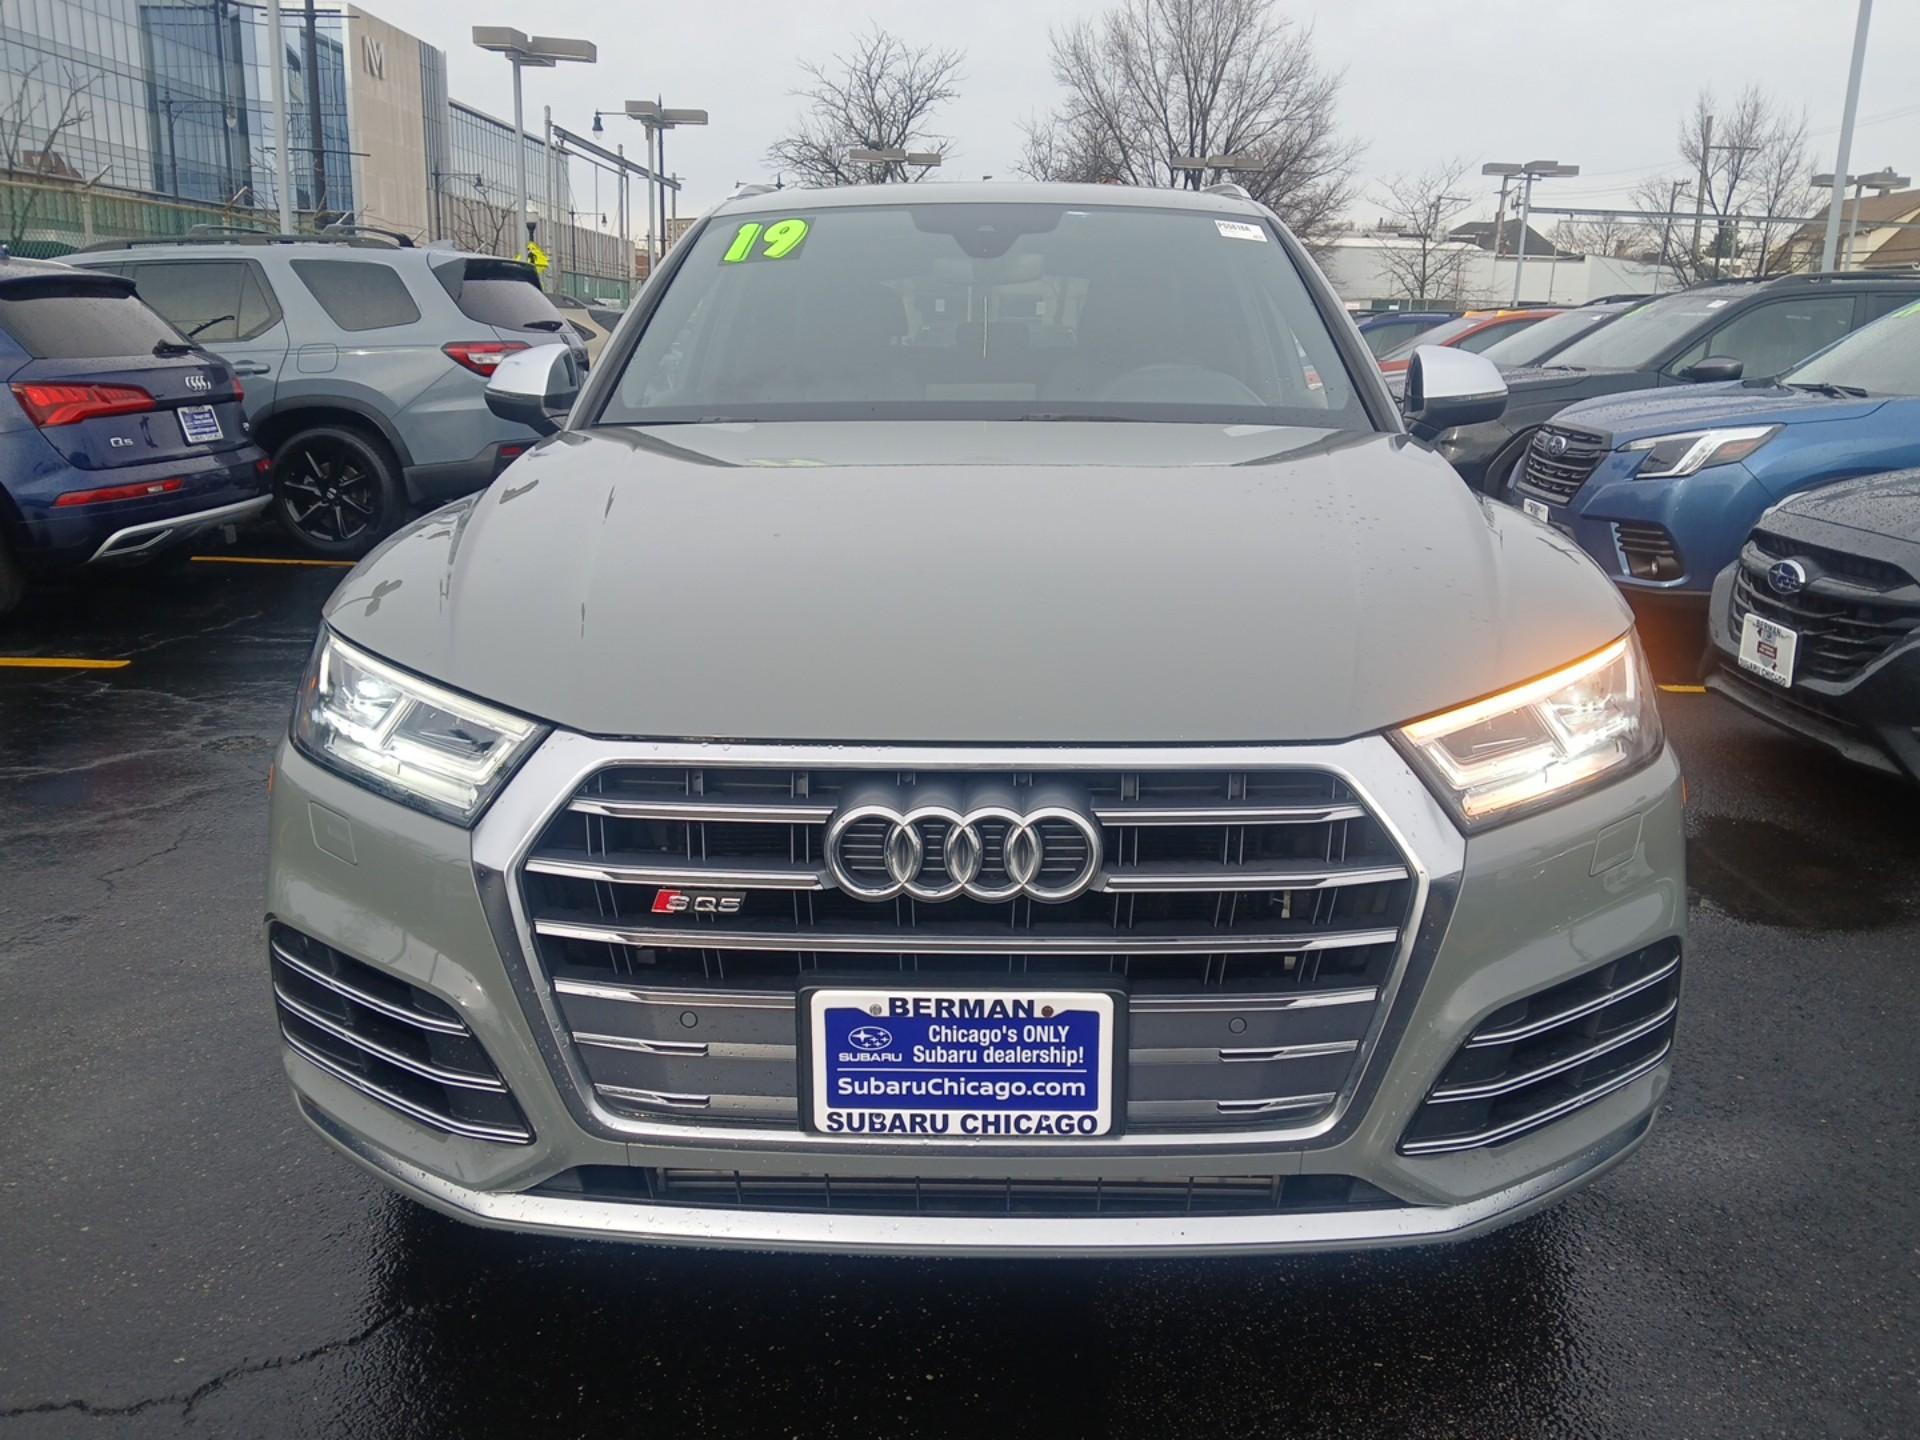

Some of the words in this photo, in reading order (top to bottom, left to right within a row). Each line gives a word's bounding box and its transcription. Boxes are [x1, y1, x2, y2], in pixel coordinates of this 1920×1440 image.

[722, 218, 809, 264] 19
[666, 895, 741, 912] SQ5
[888, 997, 1034, 1018] BERMAN
[928, 1025, 1018, 1046] Chicago's
[1023, 1025, 1069, 1043] ONLY
[838, 1052, 903, 1062] SUBARU
[912, 1045, 978, 1063] Subaru
[983, 1046, 1084, 1067] dealership!
[837, 1077, 1086, 1101] SubaruChicago.com
[826, 1111, 949, 1133] SUBARU
[960, 1113, 1098, 1135] CHICAGO
